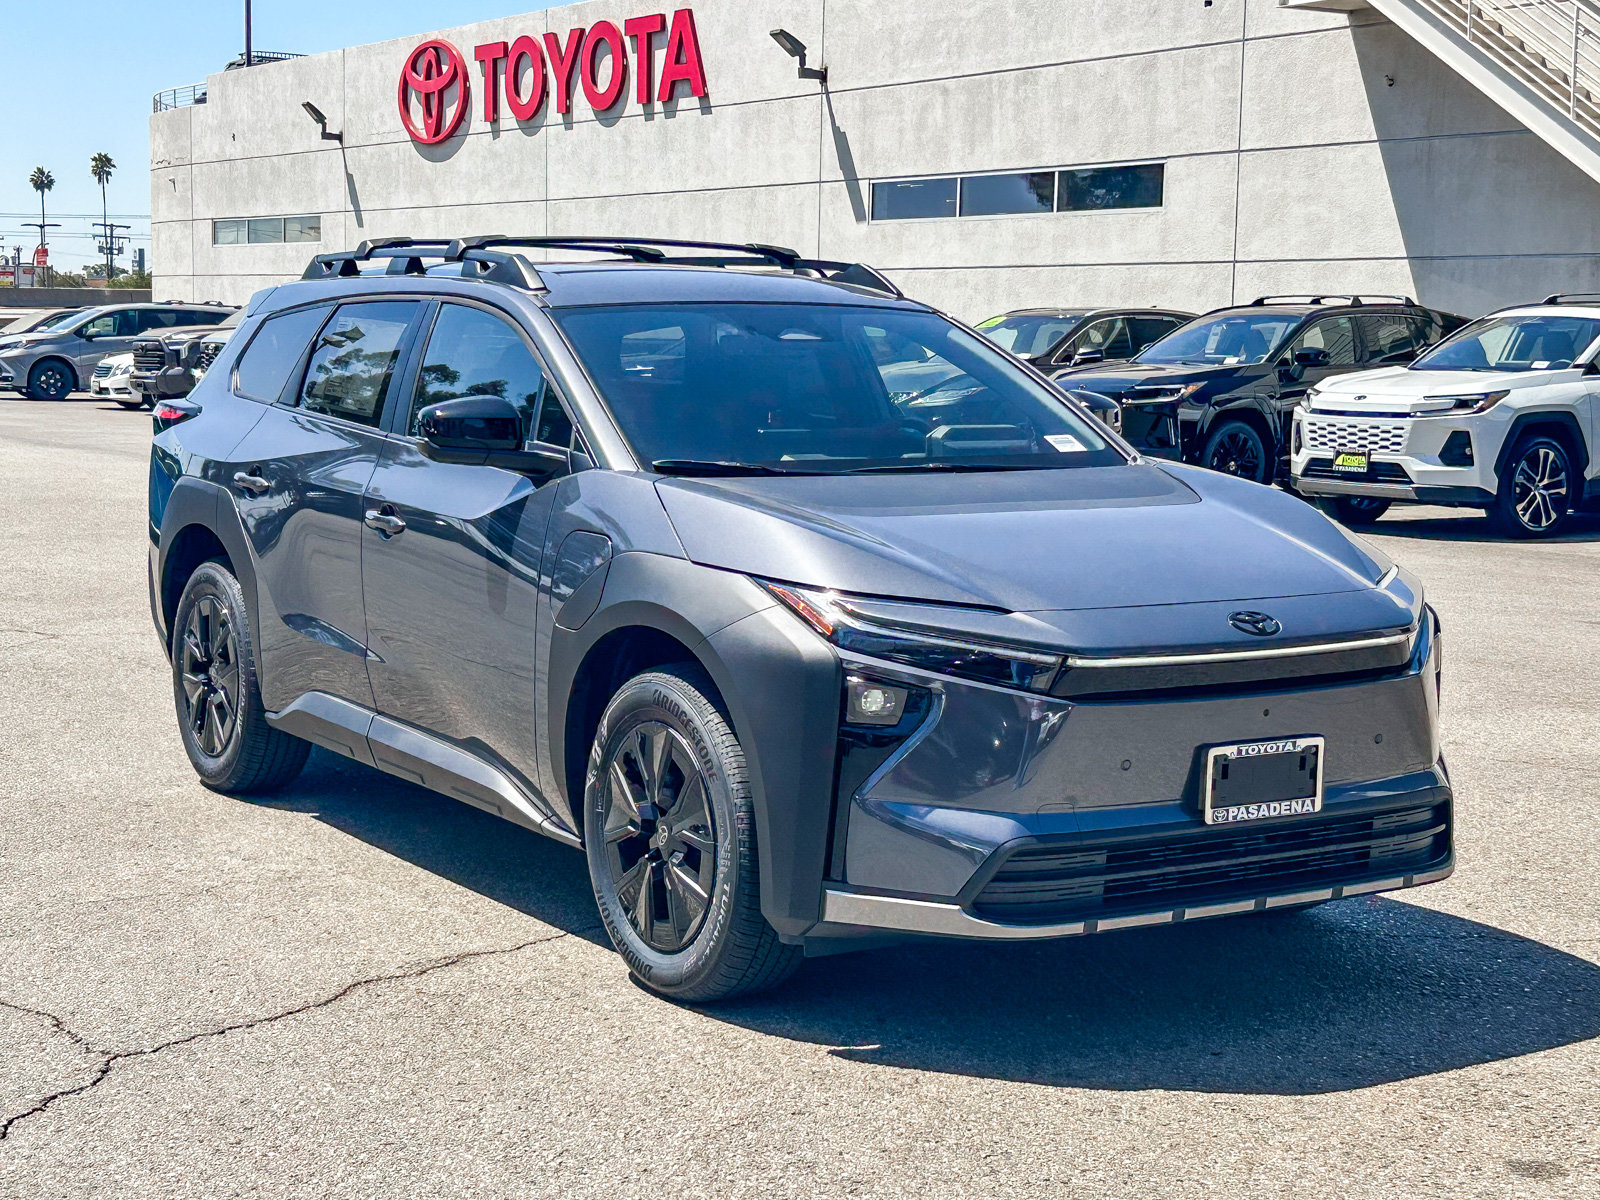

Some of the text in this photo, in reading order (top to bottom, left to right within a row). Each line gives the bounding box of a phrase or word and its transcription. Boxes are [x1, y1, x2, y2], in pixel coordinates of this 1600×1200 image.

[474, 8, 708, 122] TOYOTA
[1343, 455, 1366, 465] TOYOTA
[653, 689, 718, 784] BRIDGESTONE
[1238, 742, 1294, 756] TOYOTA
[1228, 799, 1315, 821] PASADENA
